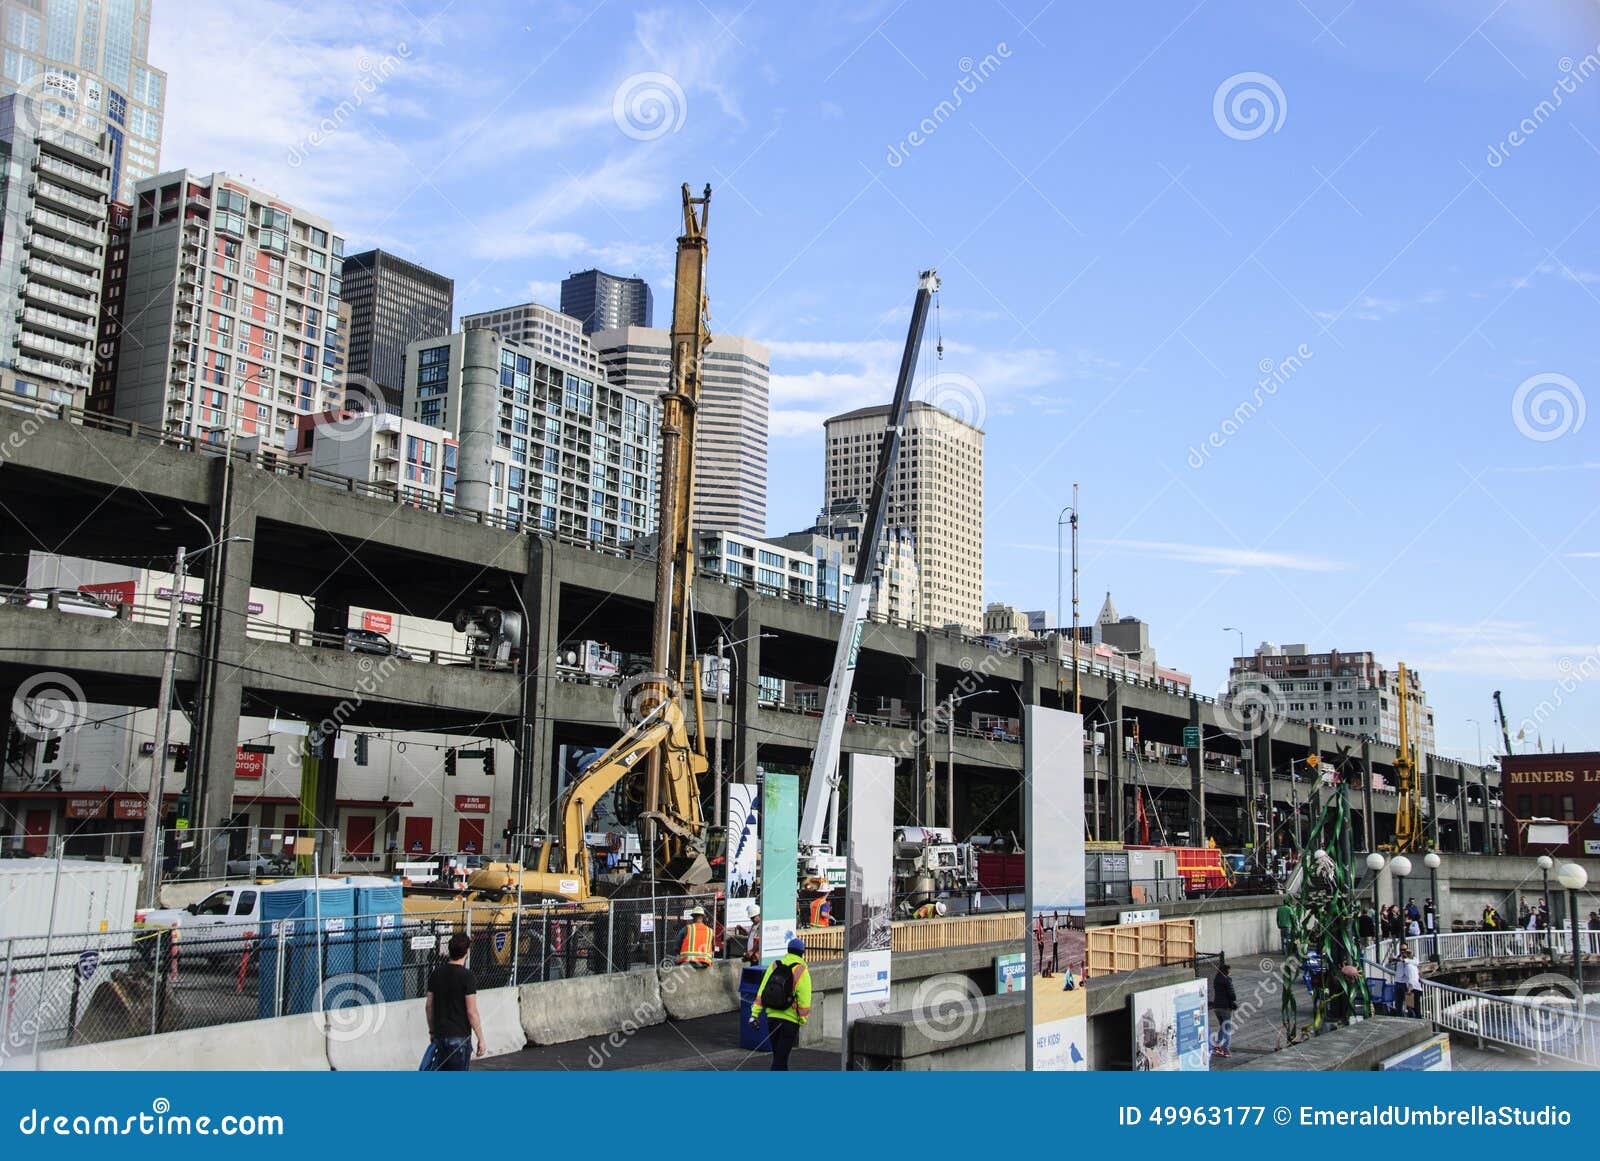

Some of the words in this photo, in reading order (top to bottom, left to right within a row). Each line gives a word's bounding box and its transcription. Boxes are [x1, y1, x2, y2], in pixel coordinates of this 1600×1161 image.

[98, 587, 123, 602] ublic
[625, 751, 638, 766] CAT
[235, 761, 260, 773] orage
[1510, 770, 1575, 784] MINERS
[1036, 1036, 1047, 1048] HEY
